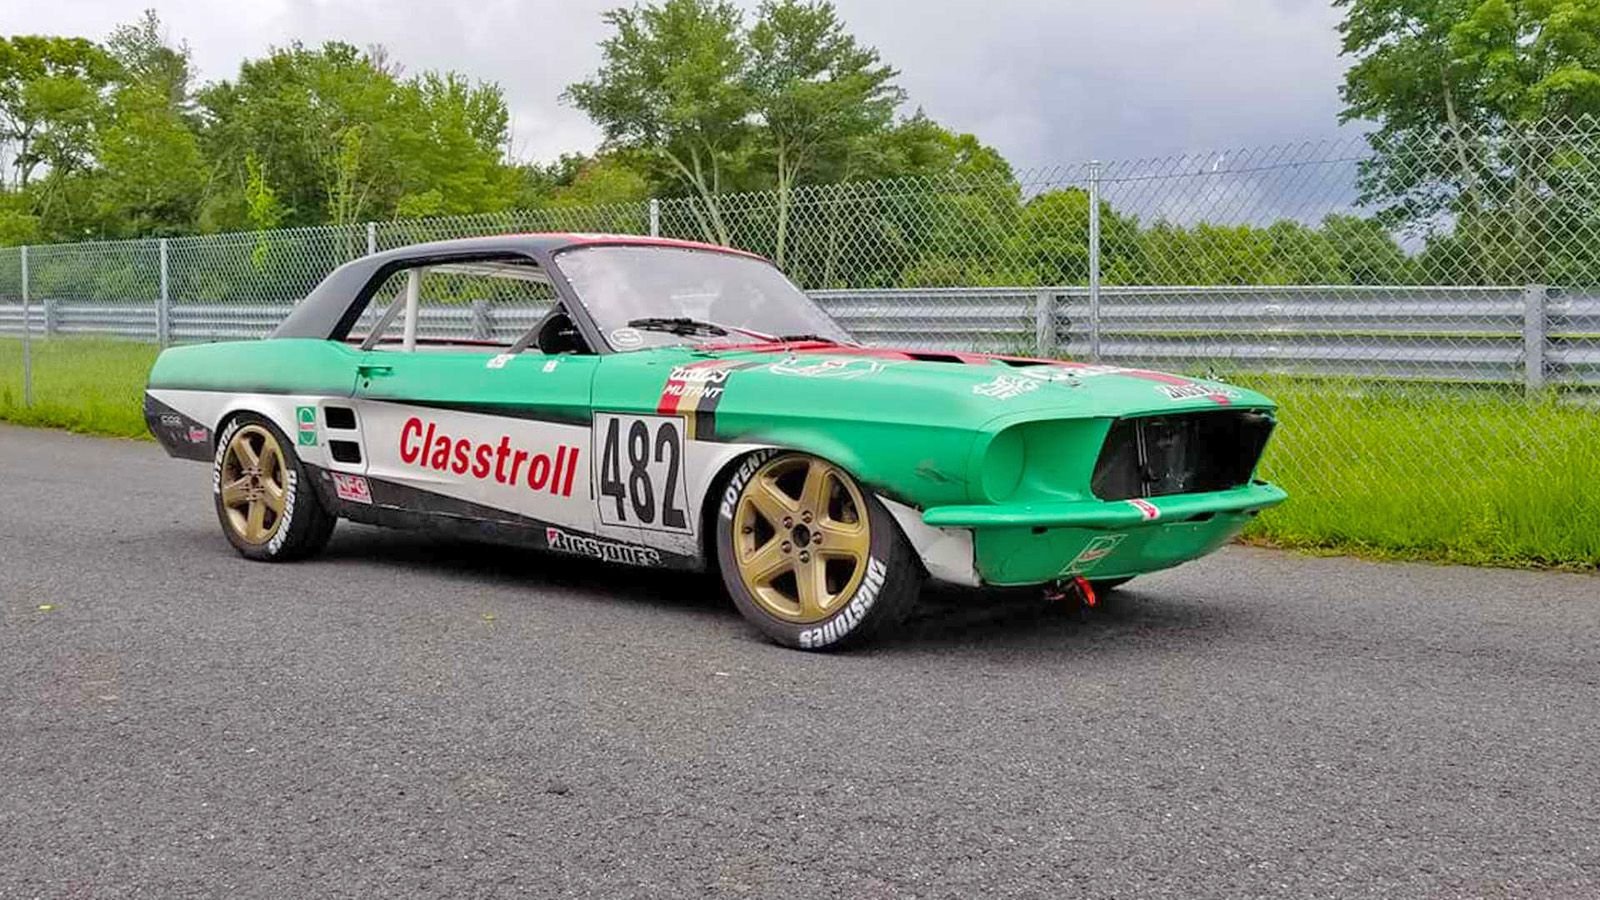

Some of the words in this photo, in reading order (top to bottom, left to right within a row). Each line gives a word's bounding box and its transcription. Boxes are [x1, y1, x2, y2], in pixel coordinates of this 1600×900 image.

[663, 384, 724, 398] MUTANT
[213, 418, 239, 494] POTENTIAL
[400, 417, 579, 497] Classtroll
[602, 417, 687, 529] 482
